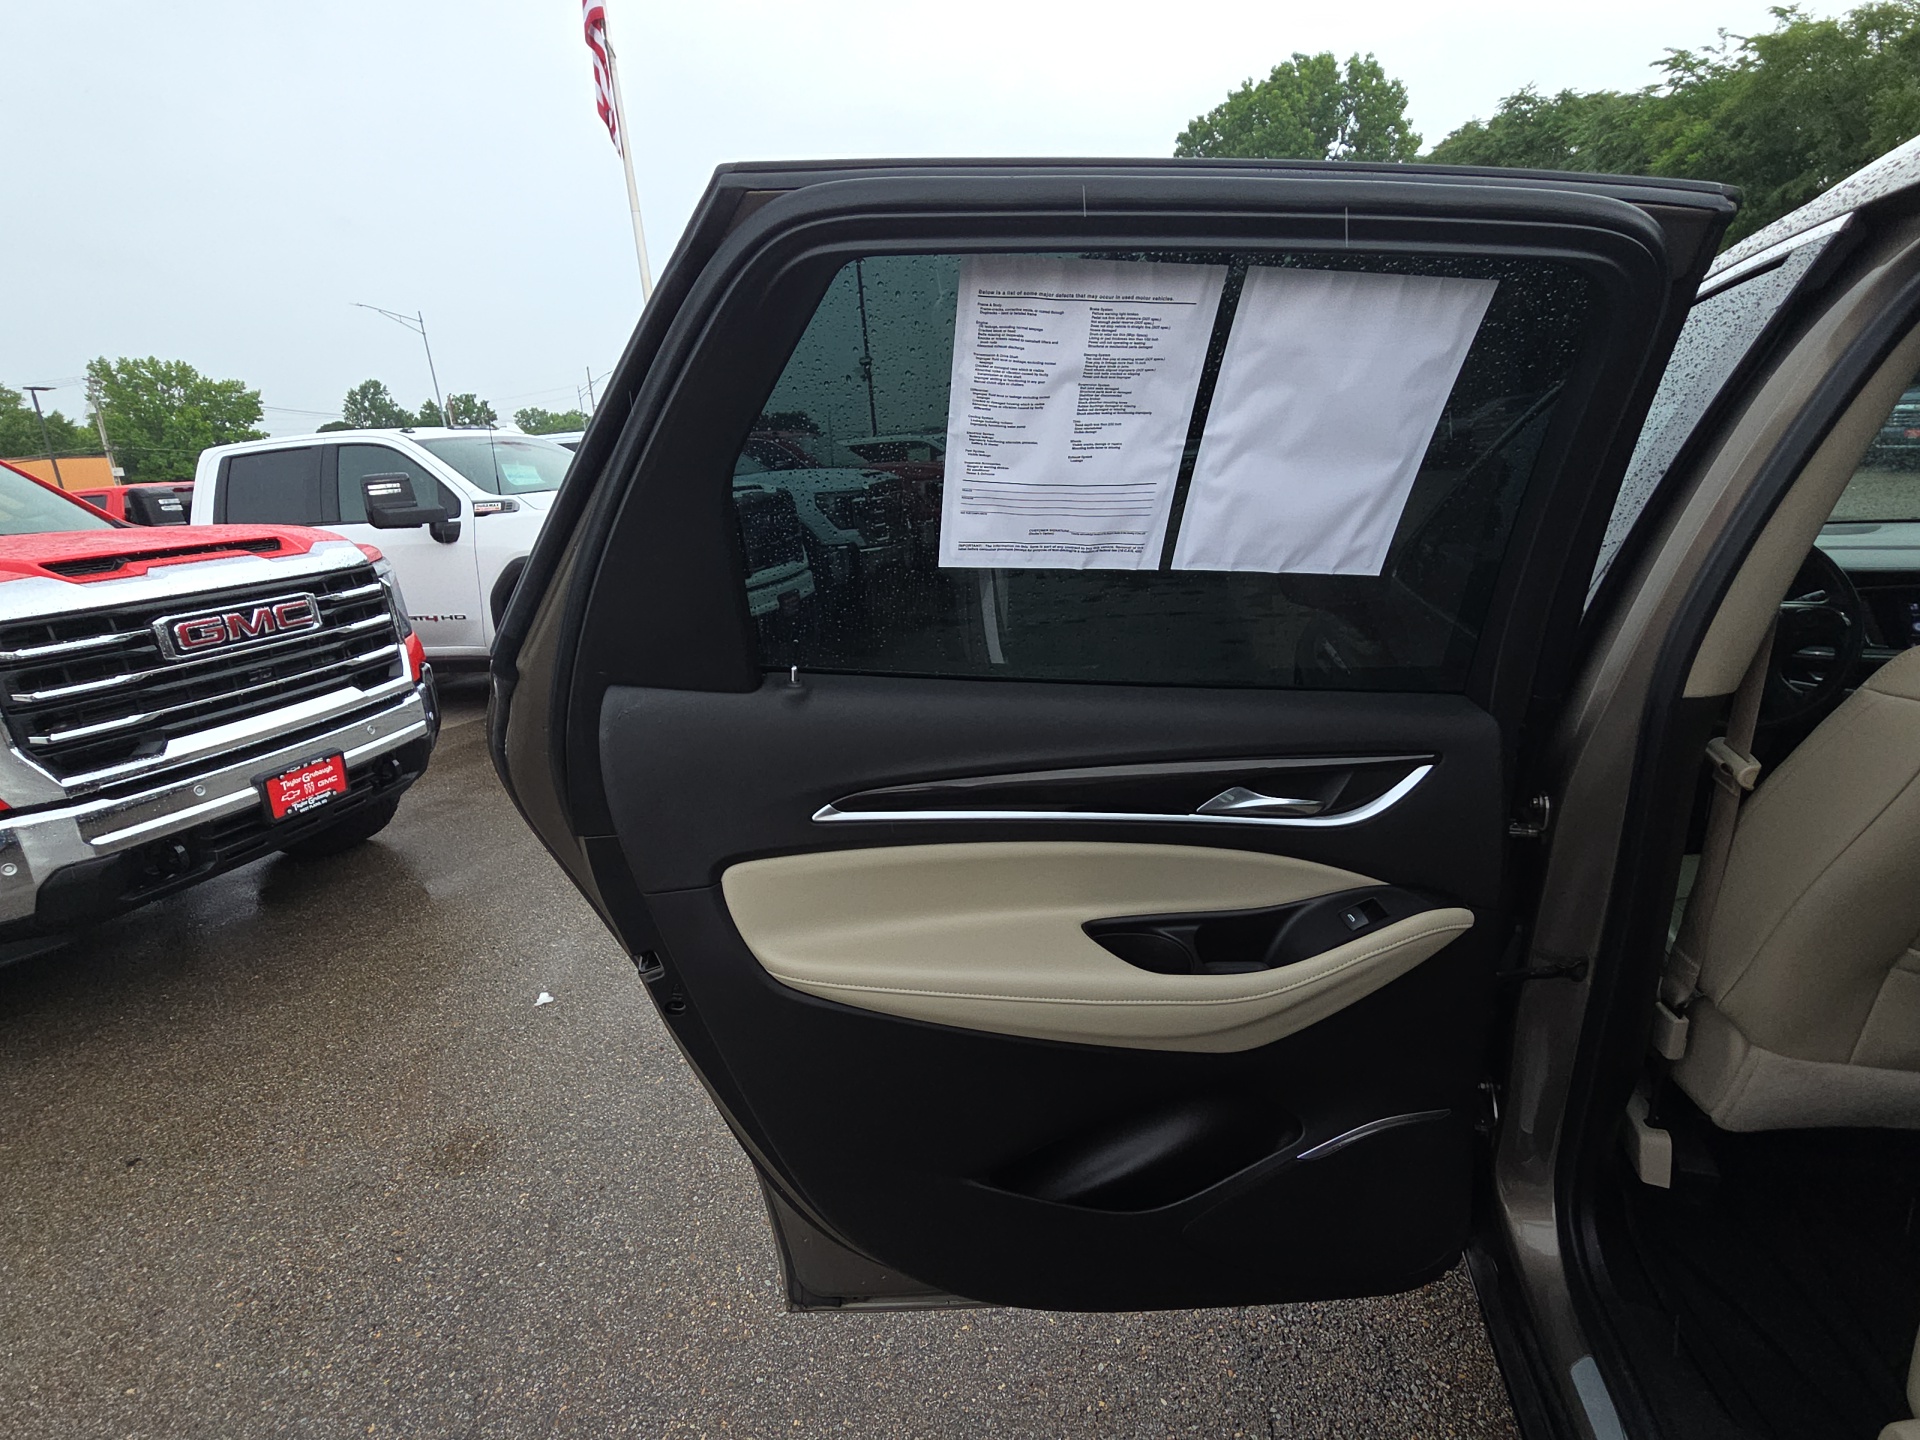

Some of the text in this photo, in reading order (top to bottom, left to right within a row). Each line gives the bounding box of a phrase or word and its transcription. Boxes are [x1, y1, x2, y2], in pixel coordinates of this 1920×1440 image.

[174, 600, 314, 650] GMC
[280, 765, 334, 791] Taylor Grubaugh
[317, 775, 338, 787] GMC
